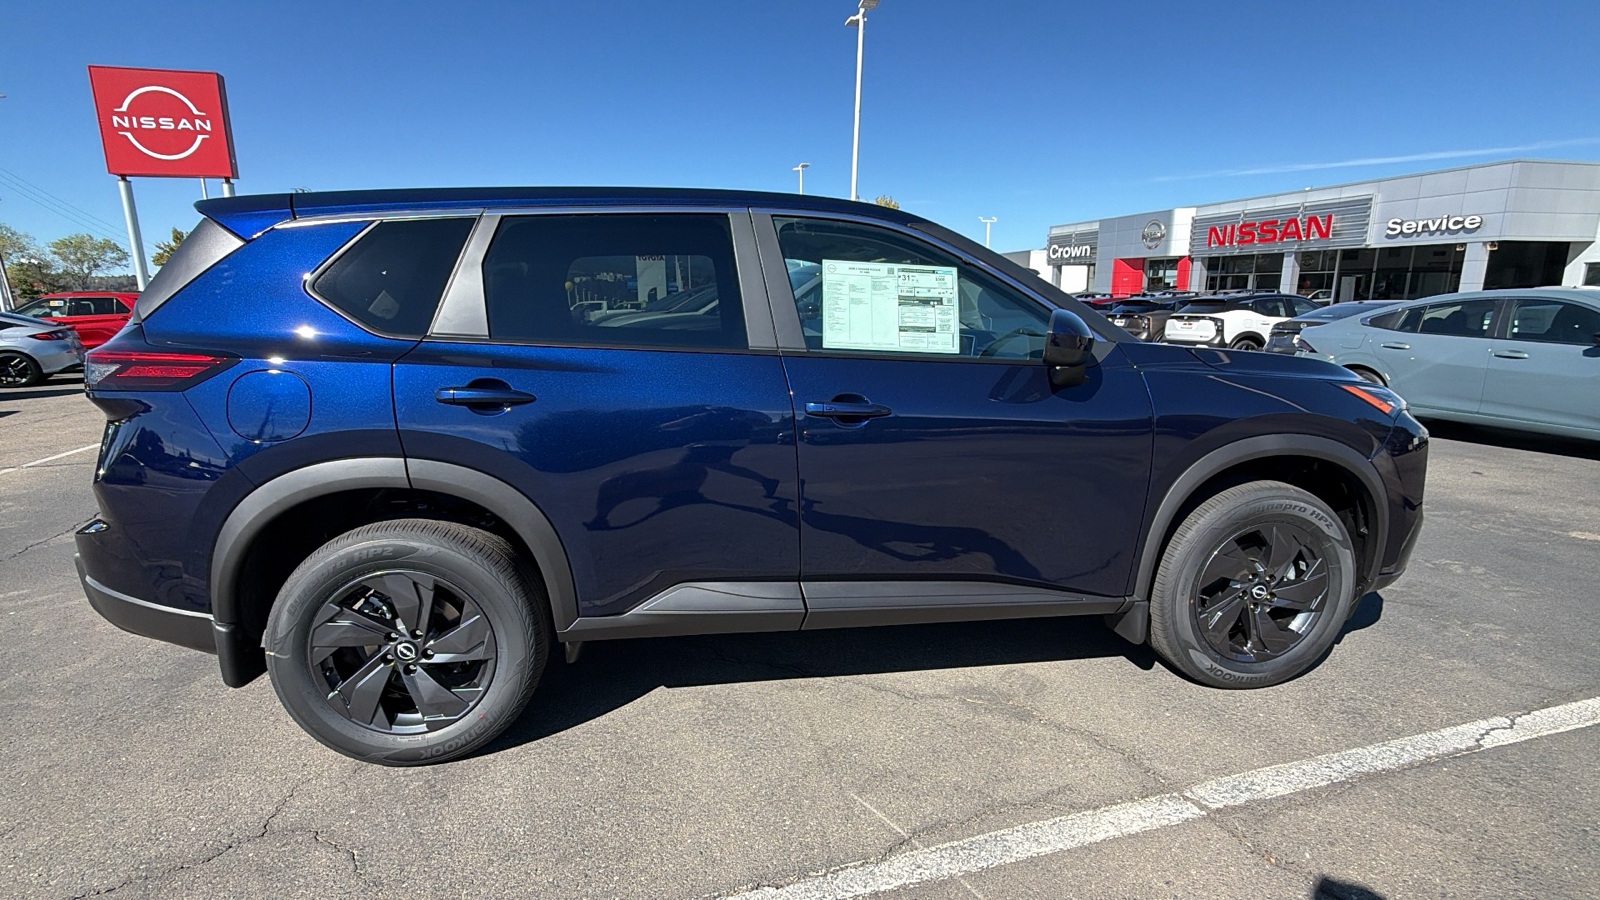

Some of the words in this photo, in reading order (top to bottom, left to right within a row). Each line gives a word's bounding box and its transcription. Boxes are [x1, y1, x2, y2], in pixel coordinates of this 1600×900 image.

[112, 115, 211, 131] NISSAN
[1207, 214, 1333, 247] NISSAN
[1386, 215, 1482, 235] Service
[1049, 245, 1091, 258] Crown
[1309, 509, 1334, 530] HP2
[353, 546, 394, 561] HP2
